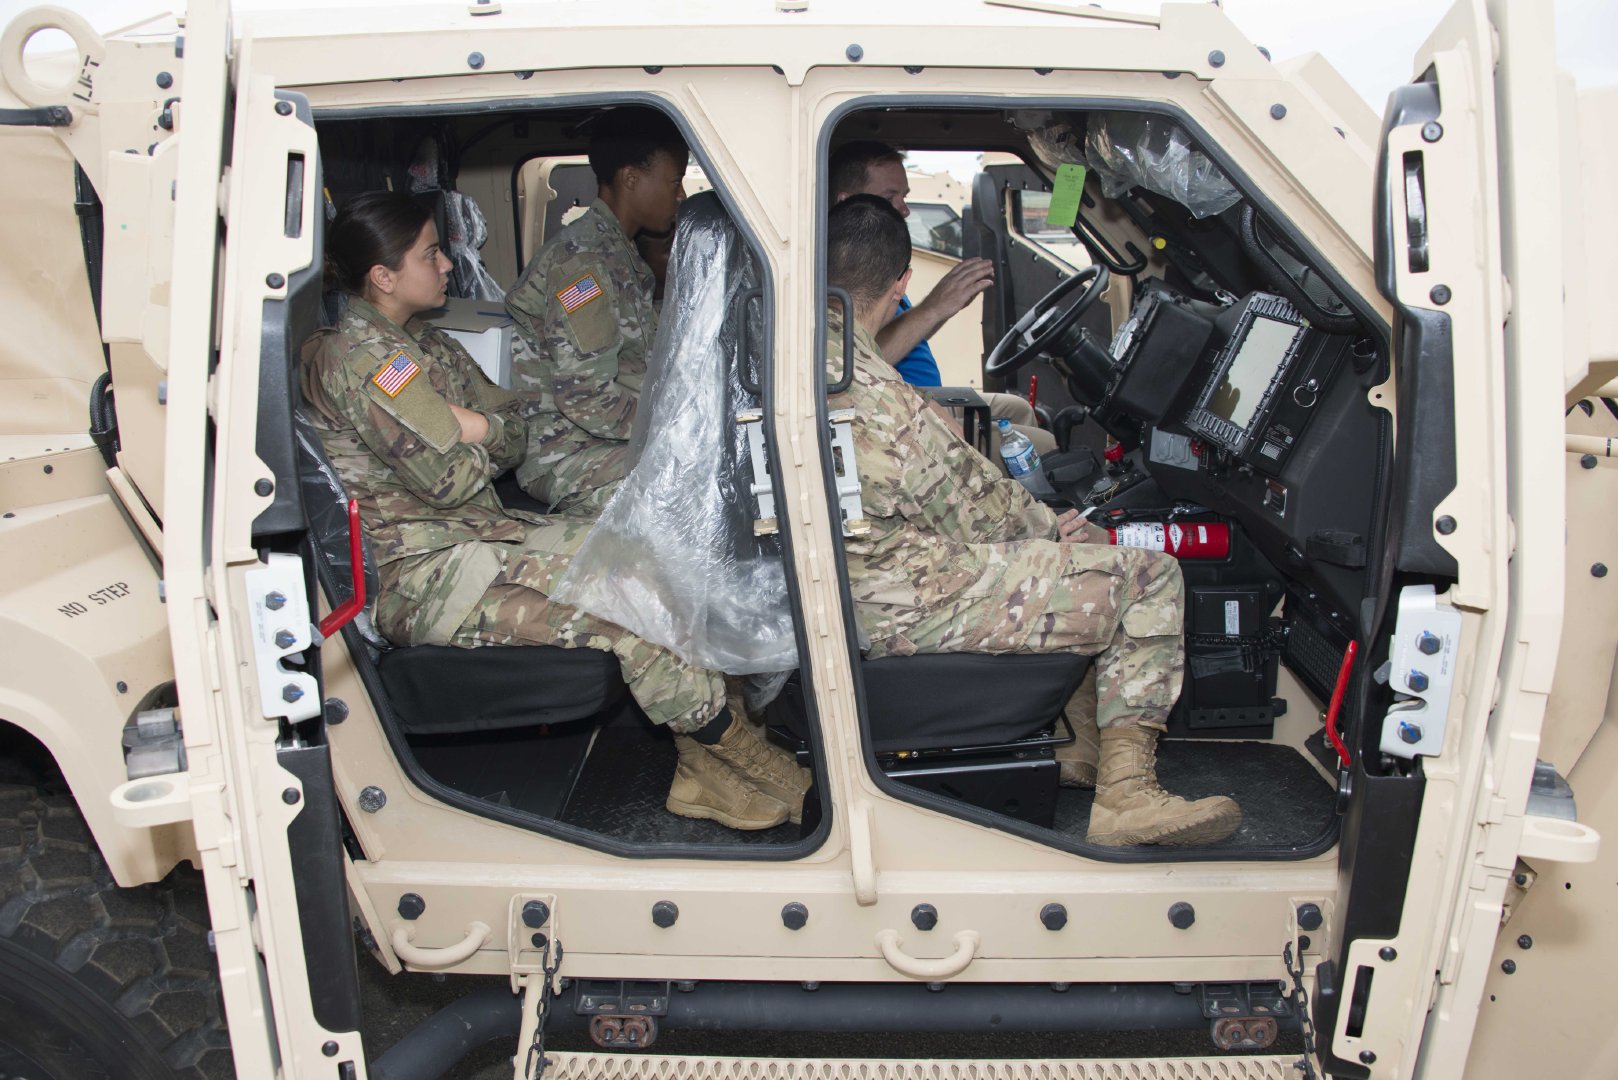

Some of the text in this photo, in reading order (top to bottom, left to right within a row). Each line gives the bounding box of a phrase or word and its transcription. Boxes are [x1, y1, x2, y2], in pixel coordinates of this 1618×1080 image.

[73, 55, 99, 102] LIFT
[57, 582, 130, 618] NO STEP
